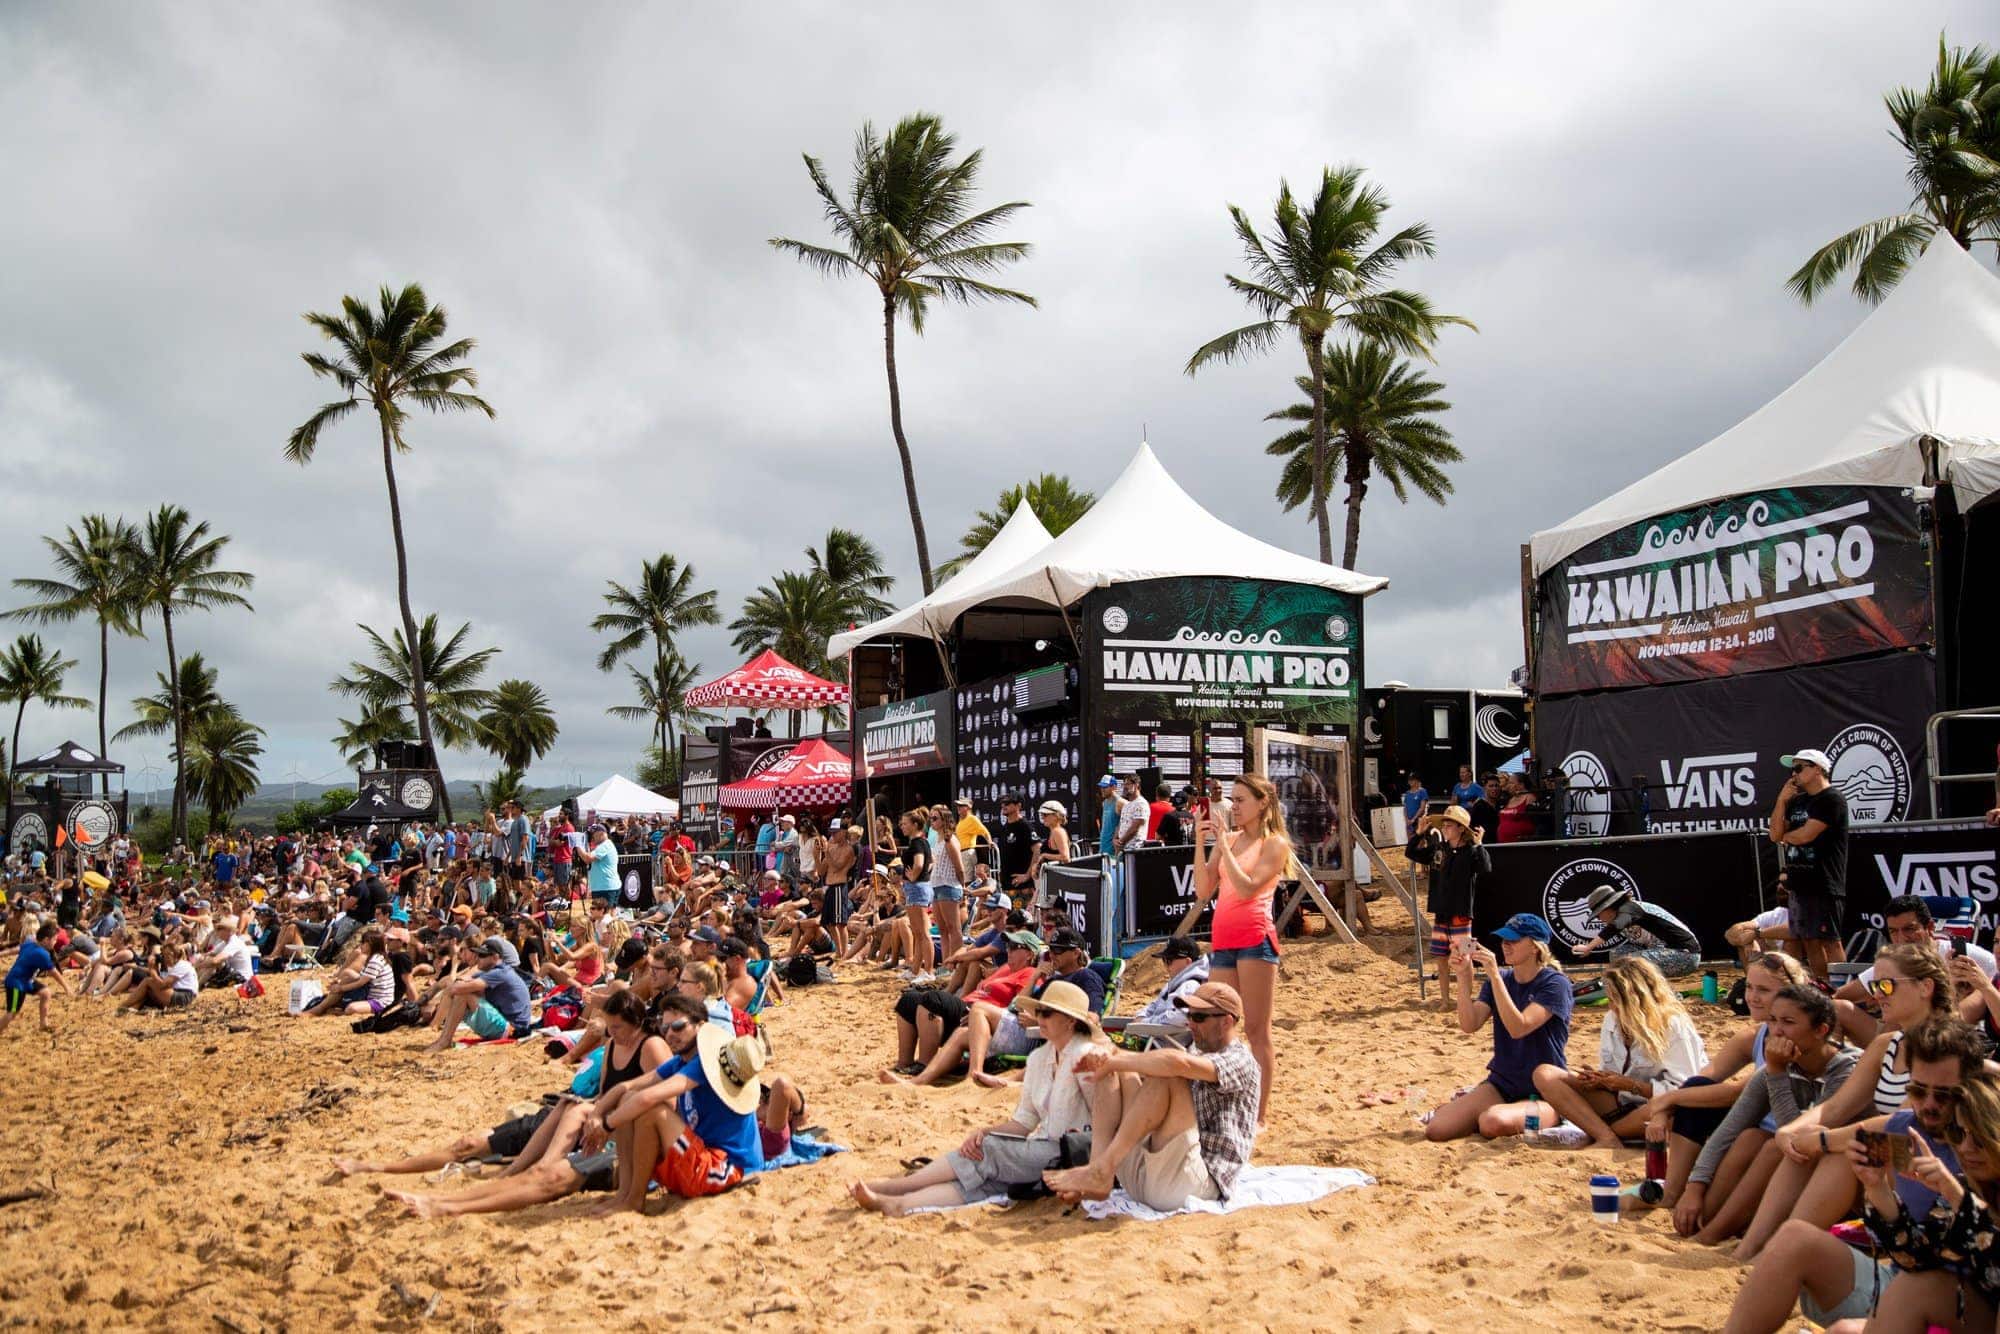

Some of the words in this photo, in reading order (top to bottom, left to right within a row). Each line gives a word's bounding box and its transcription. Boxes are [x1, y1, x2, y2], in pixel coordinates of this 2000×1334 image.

[1567, 548, 1762, 627] HAWAIIAN
[1775, 525, 1874, 594] PRO
[1714, 609, 1749, 630] Hawaii
[1638, 639, 1706, 660] NOVEMBER
[1748, 626, 1775, 646] 2018
[1103, 651, 1274, 684] HAWAIIAN
[1283, 656, 1350, 686] PRO
[1261, 700, 1284, 709] 2018
[865, 723, 913, 753] HAWAIIAN
[914, 719, 936, 745] PRO
[1848, 730, 1880, 744] CROWN
[1880, 740, 1893, 751] OF
[1890, 752, 1906, 803] SURFING
[1660, 751, 1758, 809] VANS
[1684, 820, 1717, 832] THE
[1851, 807, 1877, 820] VANS
[1551, 868, 1574, 895] TRIPLE
[1575, 863, 1609, 875] CROWN
[1609, 870, 1623, 880] OF
[1873, 850, 1999, 902] VANS
[1548, 897, 1558, 920] VANS
[1581, 920, 1608, 931] VANS
